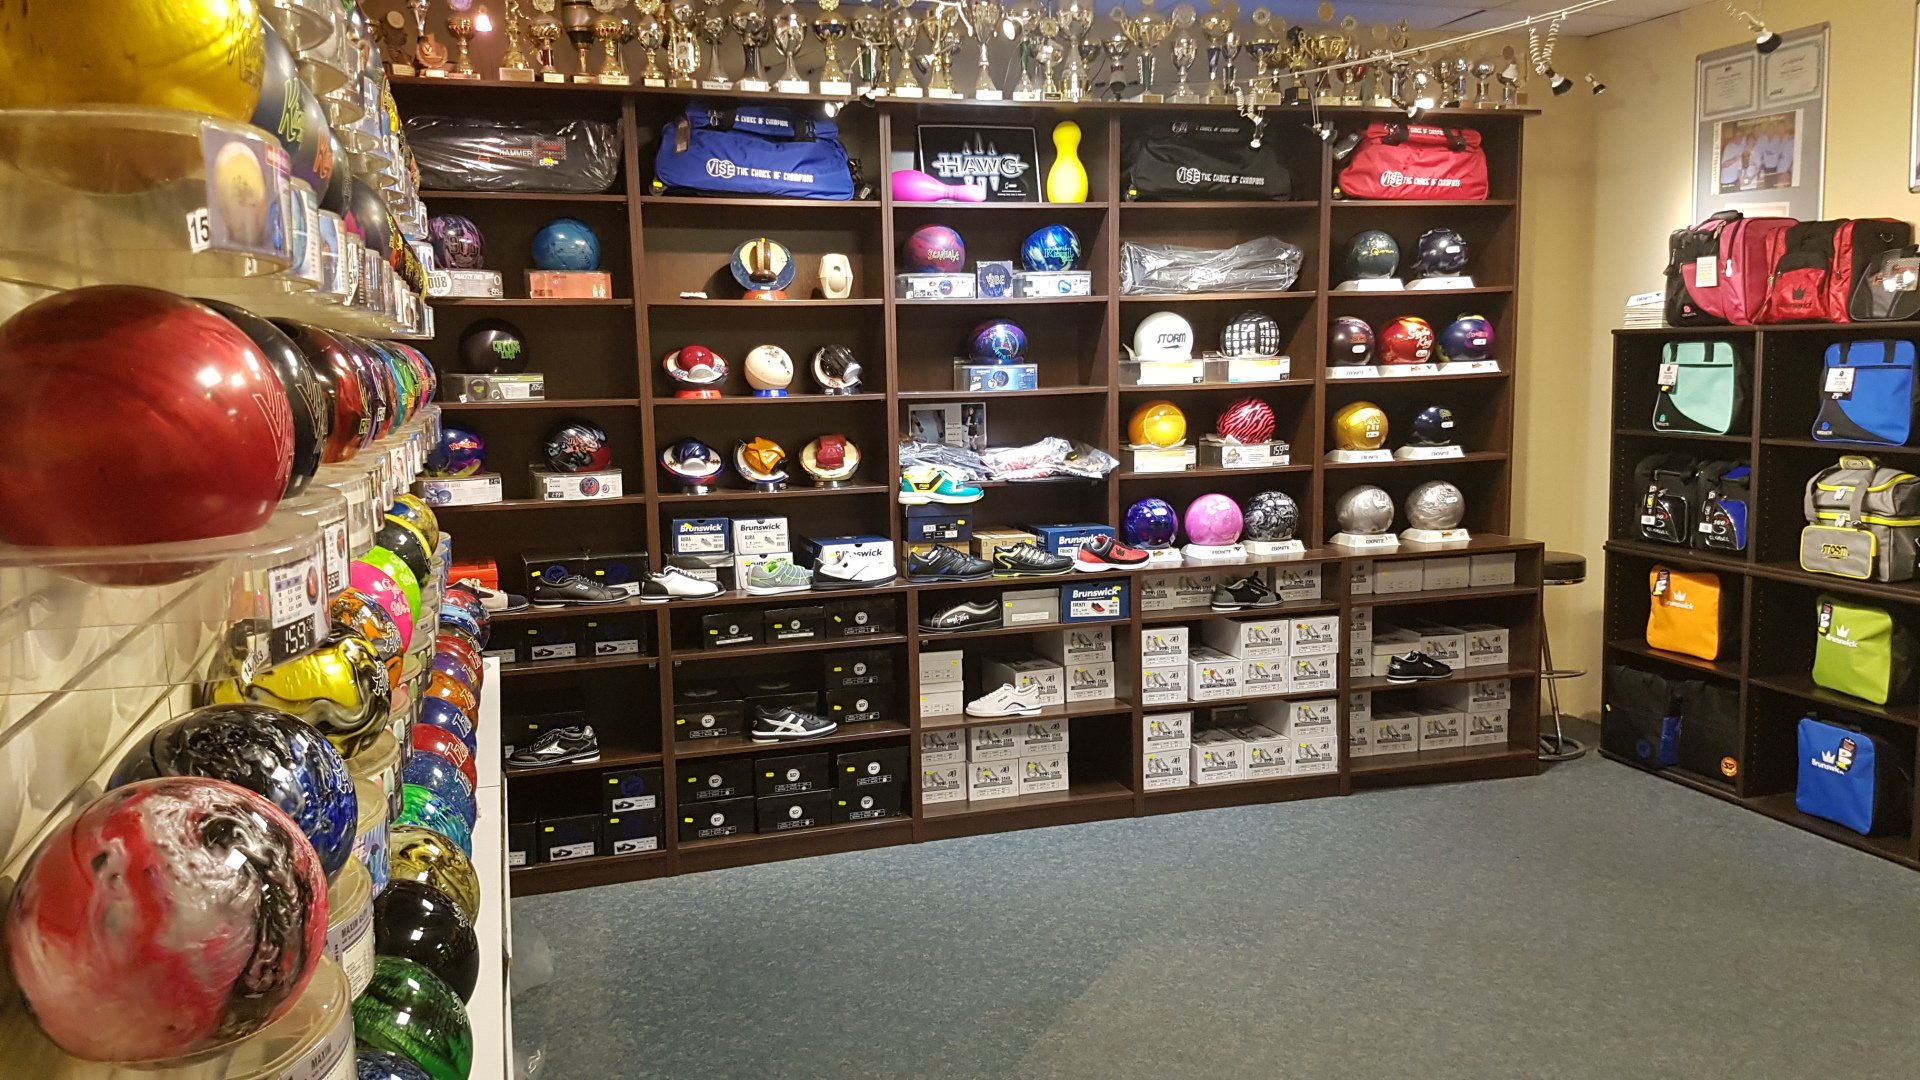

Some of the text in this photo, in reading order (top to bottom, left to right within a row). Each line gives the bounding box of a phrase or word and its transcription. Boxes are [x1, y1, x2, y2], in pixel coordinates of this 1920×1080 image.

[499, 149, 533, 157] HAMMER
[706, 160, 735, 177] VISE
[736, 167, 748, 176] THE
[751, 168, 772, 178] CHOICE
[773, 171, 782, 179] OF
[937, 152, 1023, 178] HAWG
[1177, 167, 1200, 183] VISE
[1157, 332, 1186, 343] STORM
[740, 523, 781, 532] Brunswick
[1822, 544, 1849, 556] STORM
[1073, 588, 1118, 598] Brunswick
[341, 918, 359, 938] MAXIM
[311, 1042, 332, 1071] MAXIM
